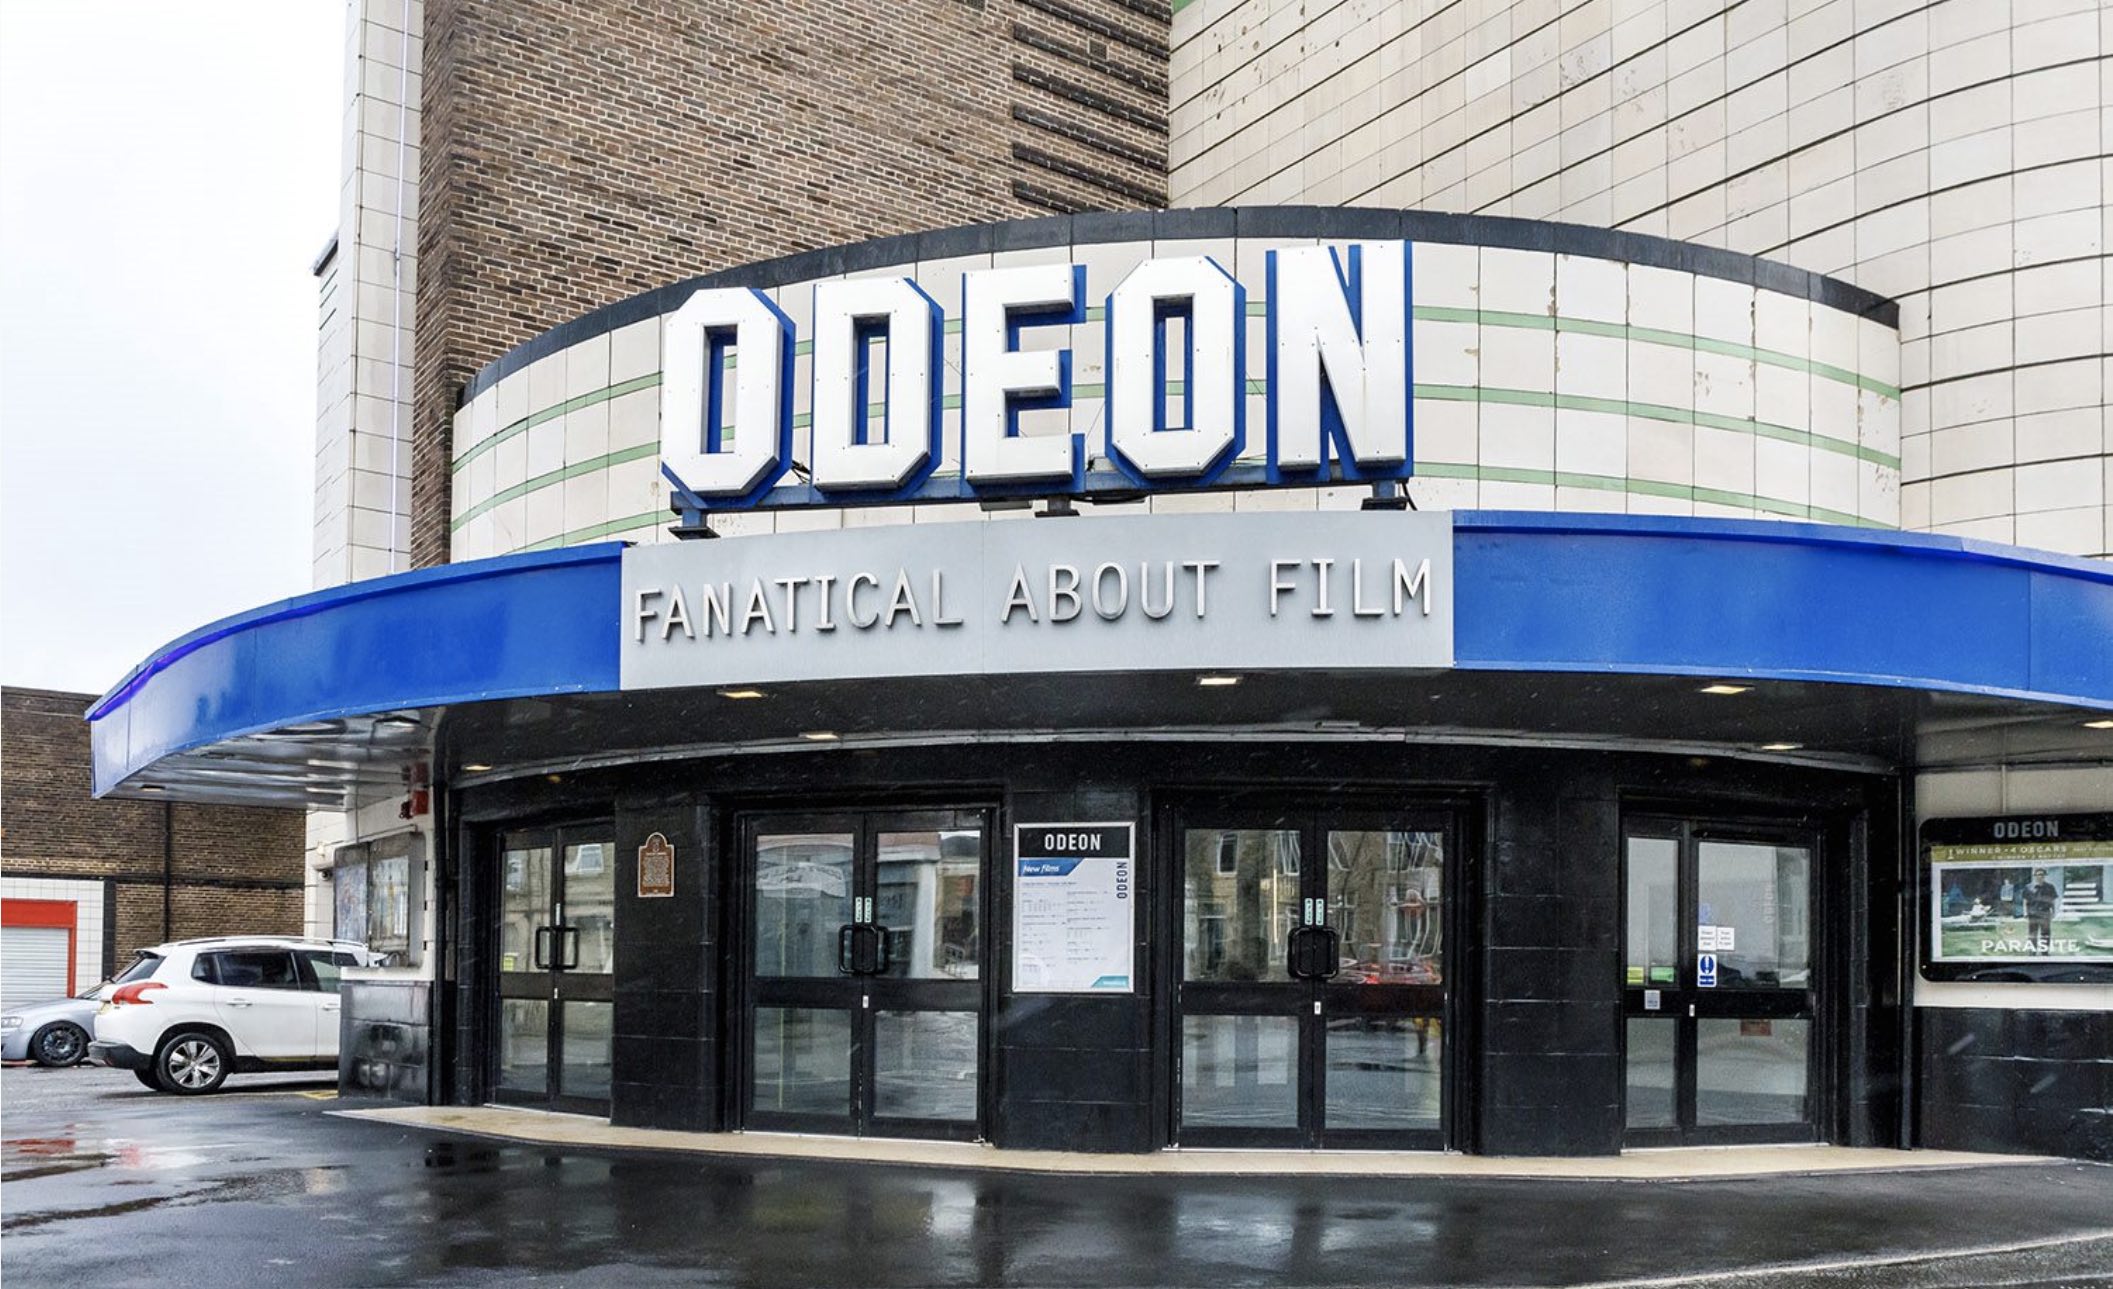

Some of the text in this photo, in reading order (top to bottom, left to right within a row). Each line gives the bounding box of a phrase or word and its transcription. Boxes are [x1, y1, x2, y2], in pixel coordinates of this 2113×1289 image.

[661, 239, 1413, 508] ODEON
[634, 558, 1431, 642] FANATICAL ABOUT FILM
[1994, 820, 2058, 838] ODEON
[1044, 833, 1101, 850] ODEON
[1956, 847, 2000, 855] WINNER
[2020, 845, 2067, 853] OSCARS
[1023, 864, 1040, 873] New
[1116, 861, 1128, 899] ODEON
[1981, 939, 2079, 953] PARASITE
